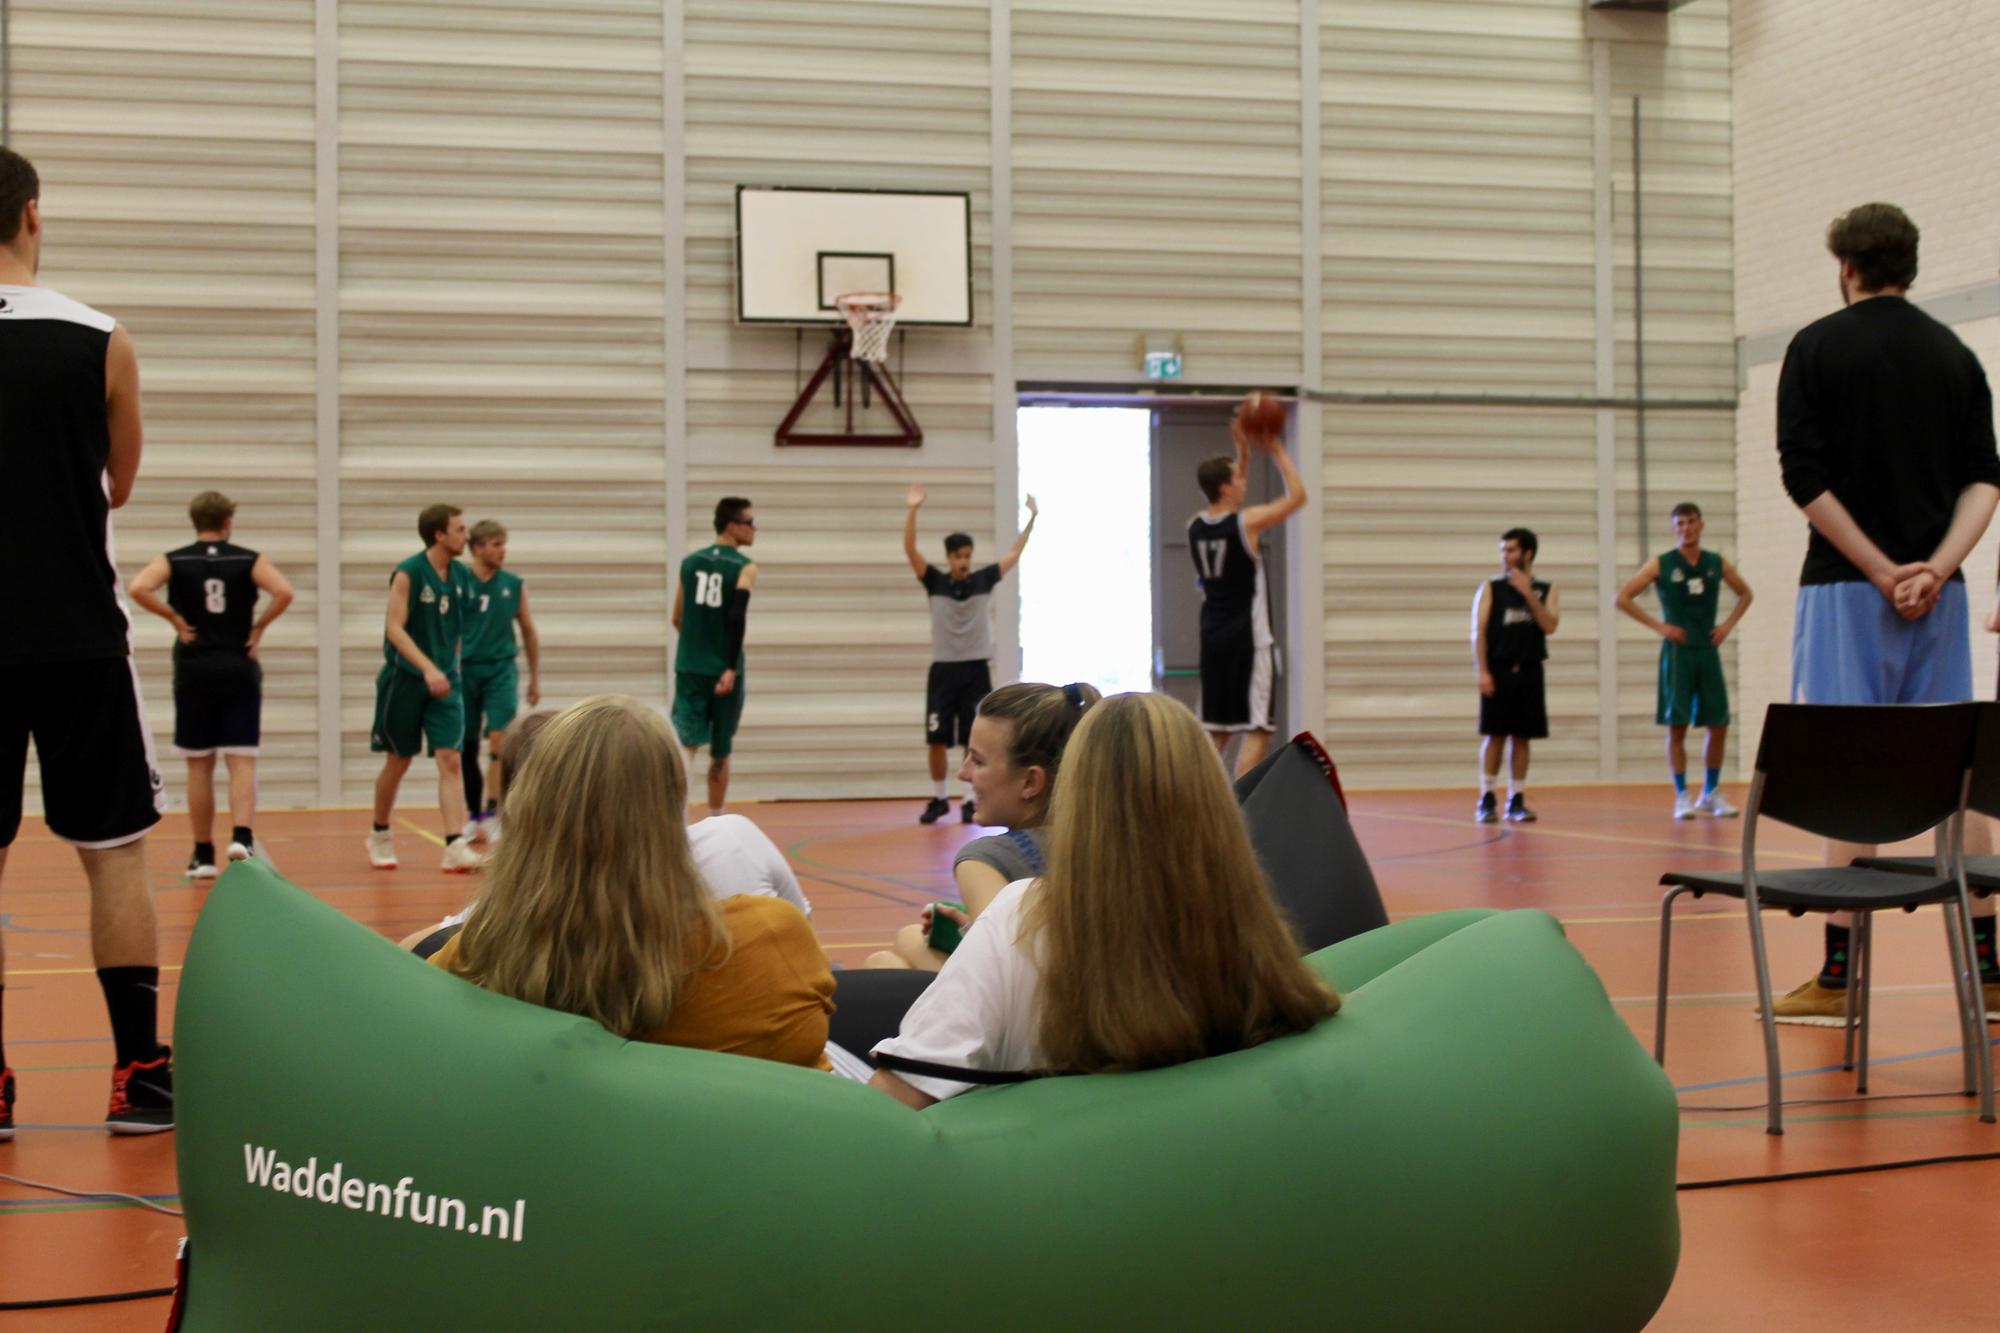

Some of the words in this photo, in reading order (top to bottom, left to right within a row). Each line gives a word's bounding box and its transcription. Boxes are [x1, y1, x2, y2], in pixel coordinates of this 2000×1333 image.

[1198, 539, 1227, 578] 17
[204, 578, 226, 613] 8
[695, 570, 723, 607] 18
[929, 713, 939, 731] 5
[243, 1143, 526, 1241] Waddenfun.nl
